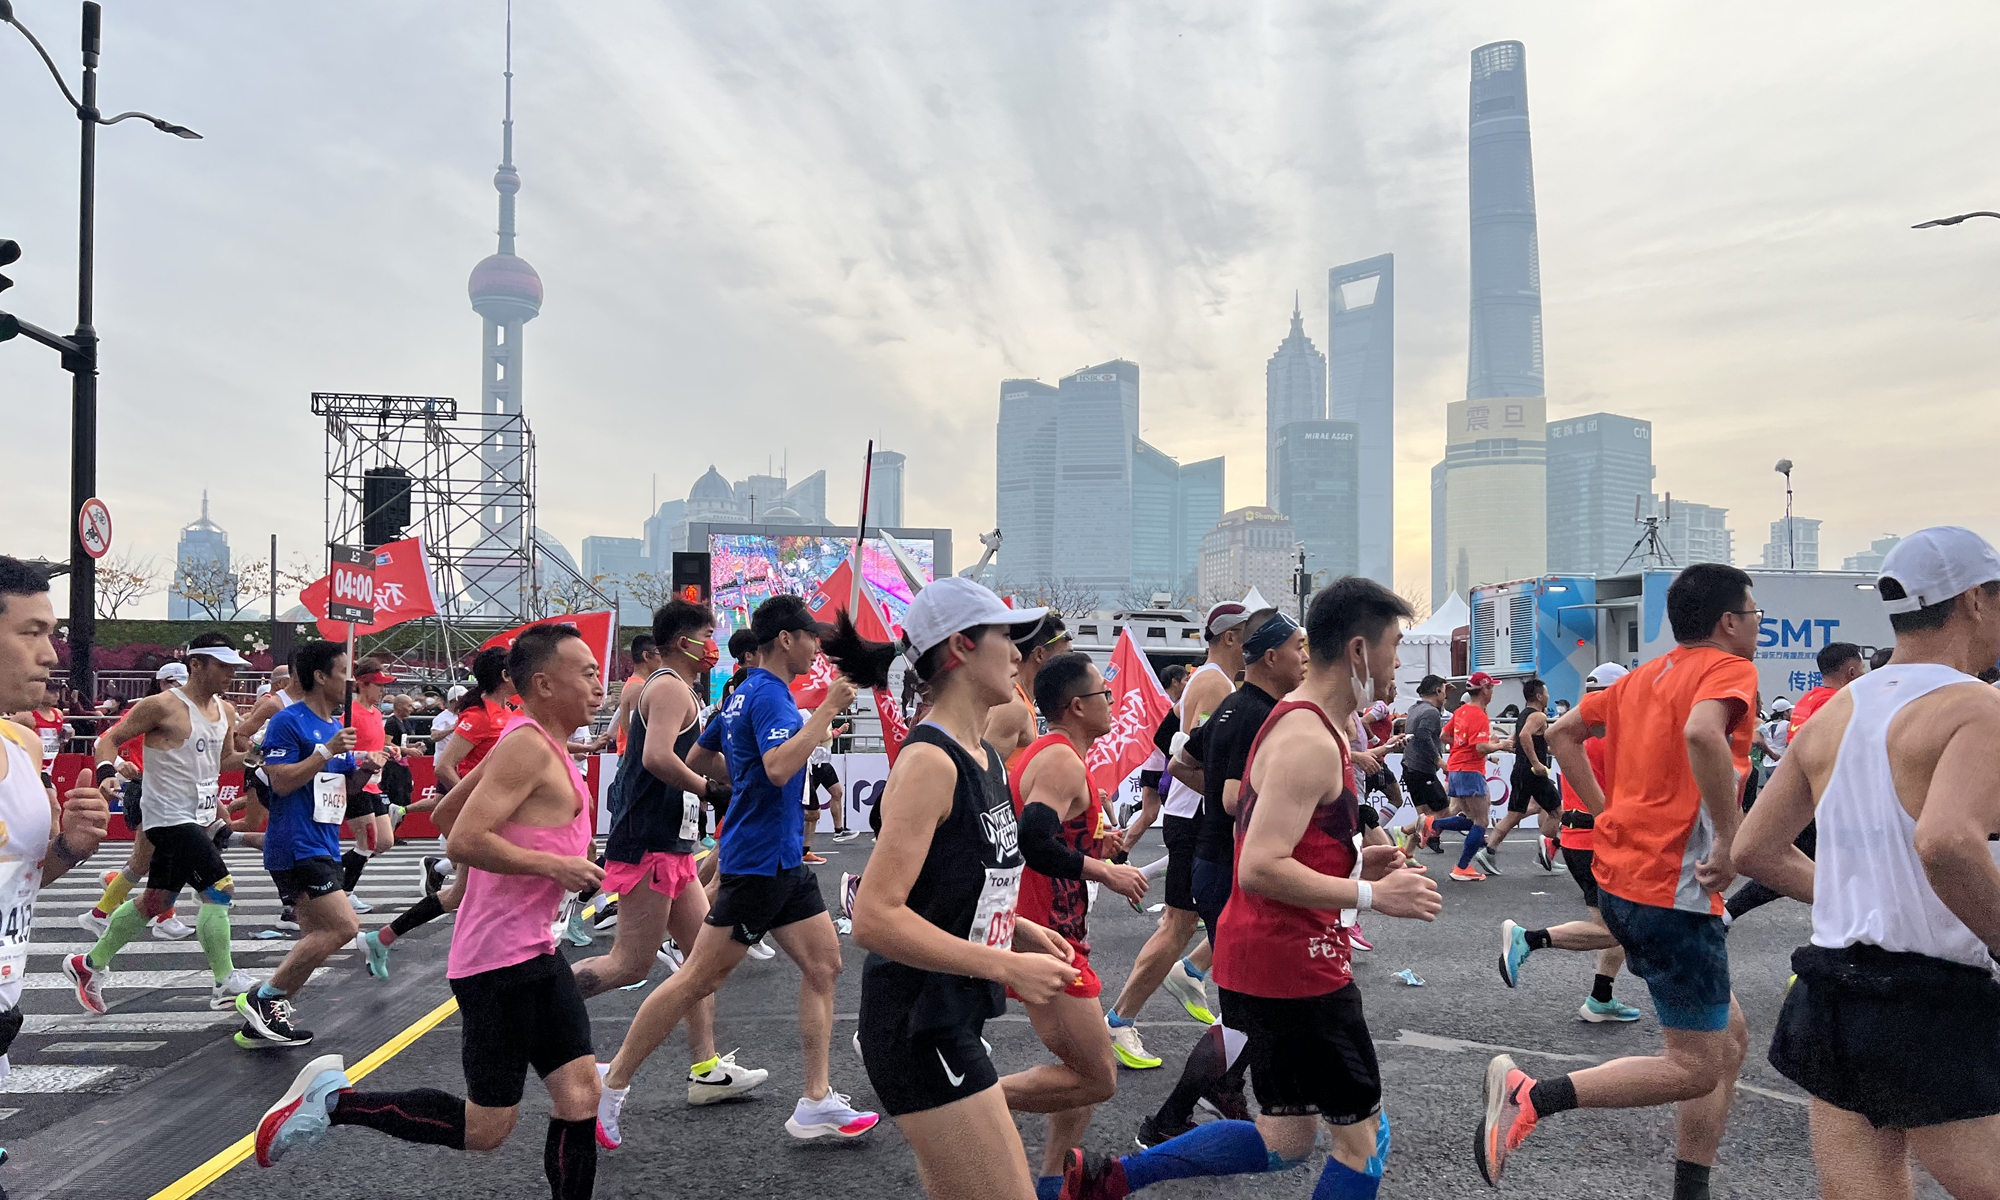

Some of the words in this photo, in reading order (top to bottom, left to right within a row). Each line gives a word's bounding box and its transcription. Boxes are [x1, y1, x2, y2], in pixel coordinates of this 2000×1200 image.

[1466, 405, 1525, 432] 震旦
[1331, 432, 1354, 441] ASSET
[1551, 420, 1598, 439] 花旗集团
[1633, 426, 1649, 440] citi
[335, 568, 373, 604] 04:00
